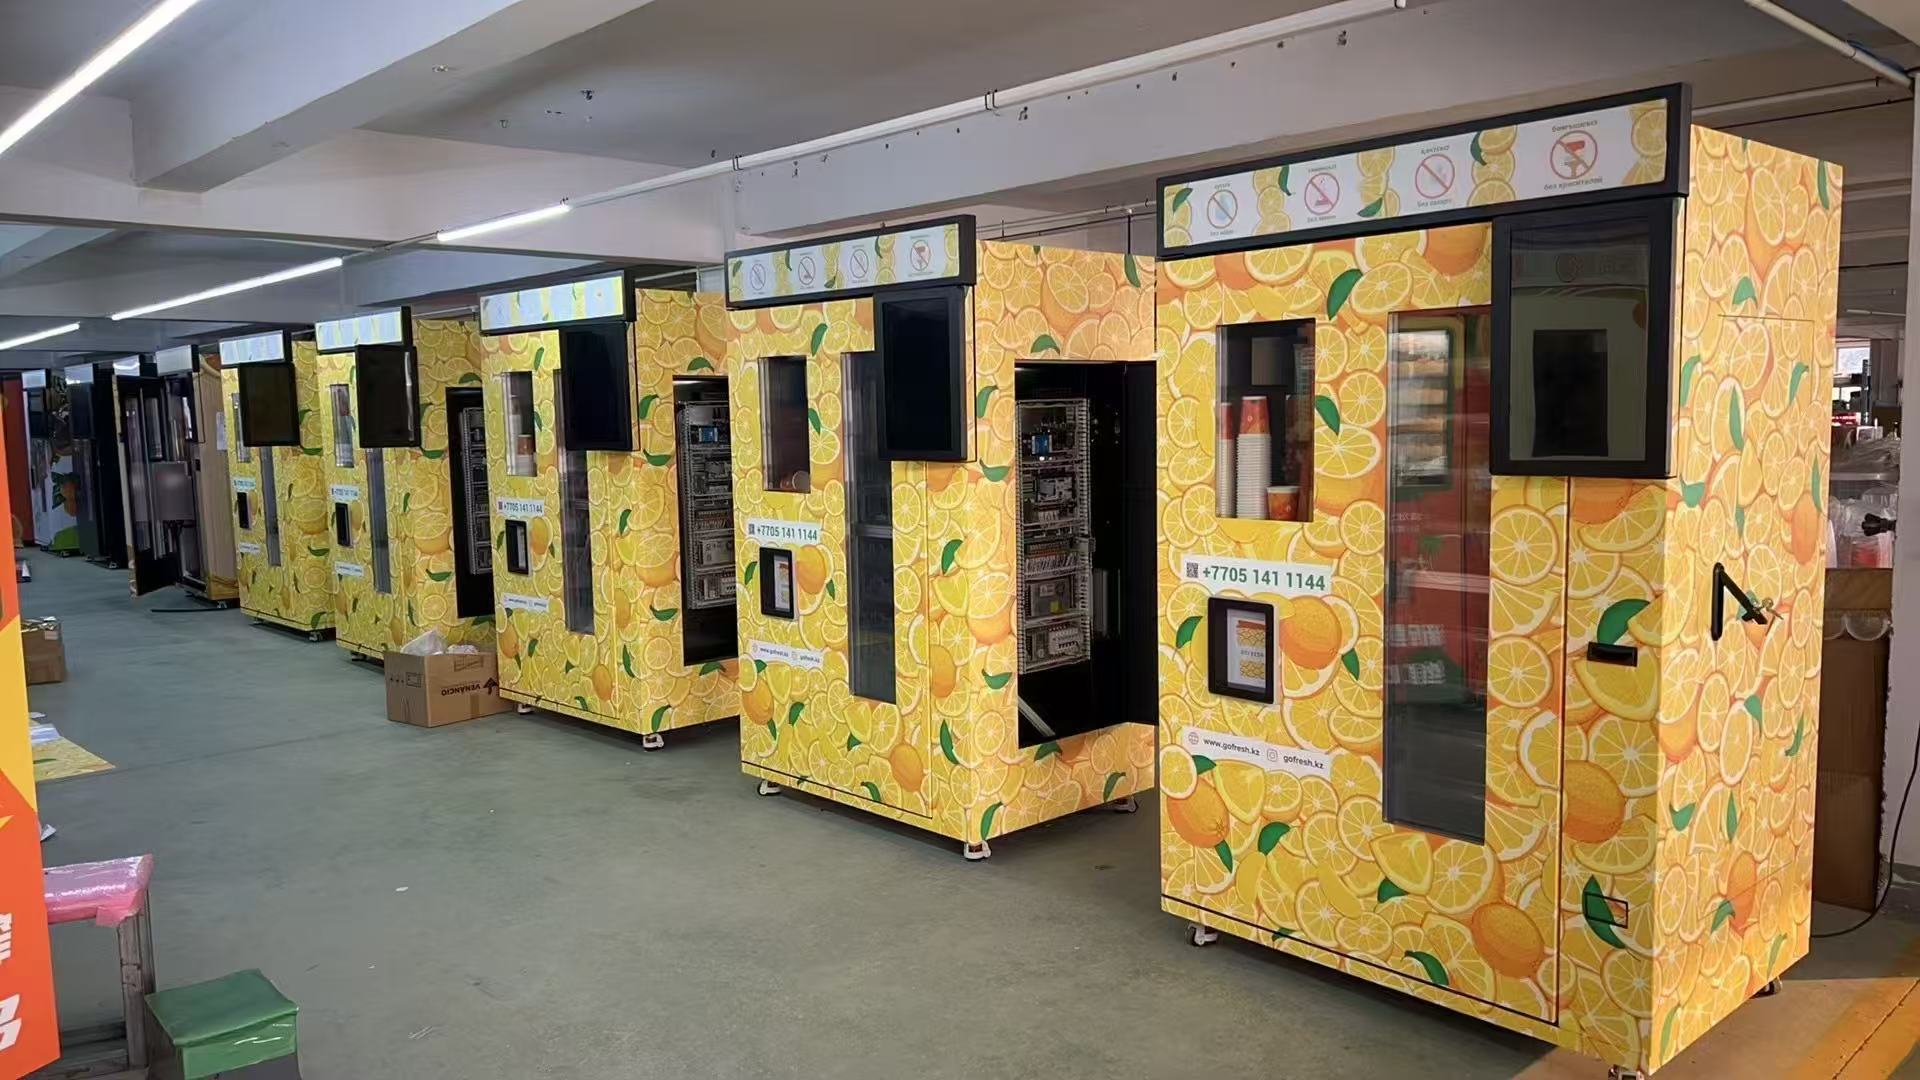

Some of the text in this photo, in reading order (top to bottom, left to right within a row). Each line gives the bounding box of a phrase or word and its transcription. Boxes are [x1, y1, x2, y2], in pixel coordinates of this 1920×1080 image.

[757, 525, 817, 541] +7705 141 1144
[1202, 565, 1326, 591] +7705 141 1144
[1203, 738, 1325, 770] www.gofresh.kz gofresh.kz
